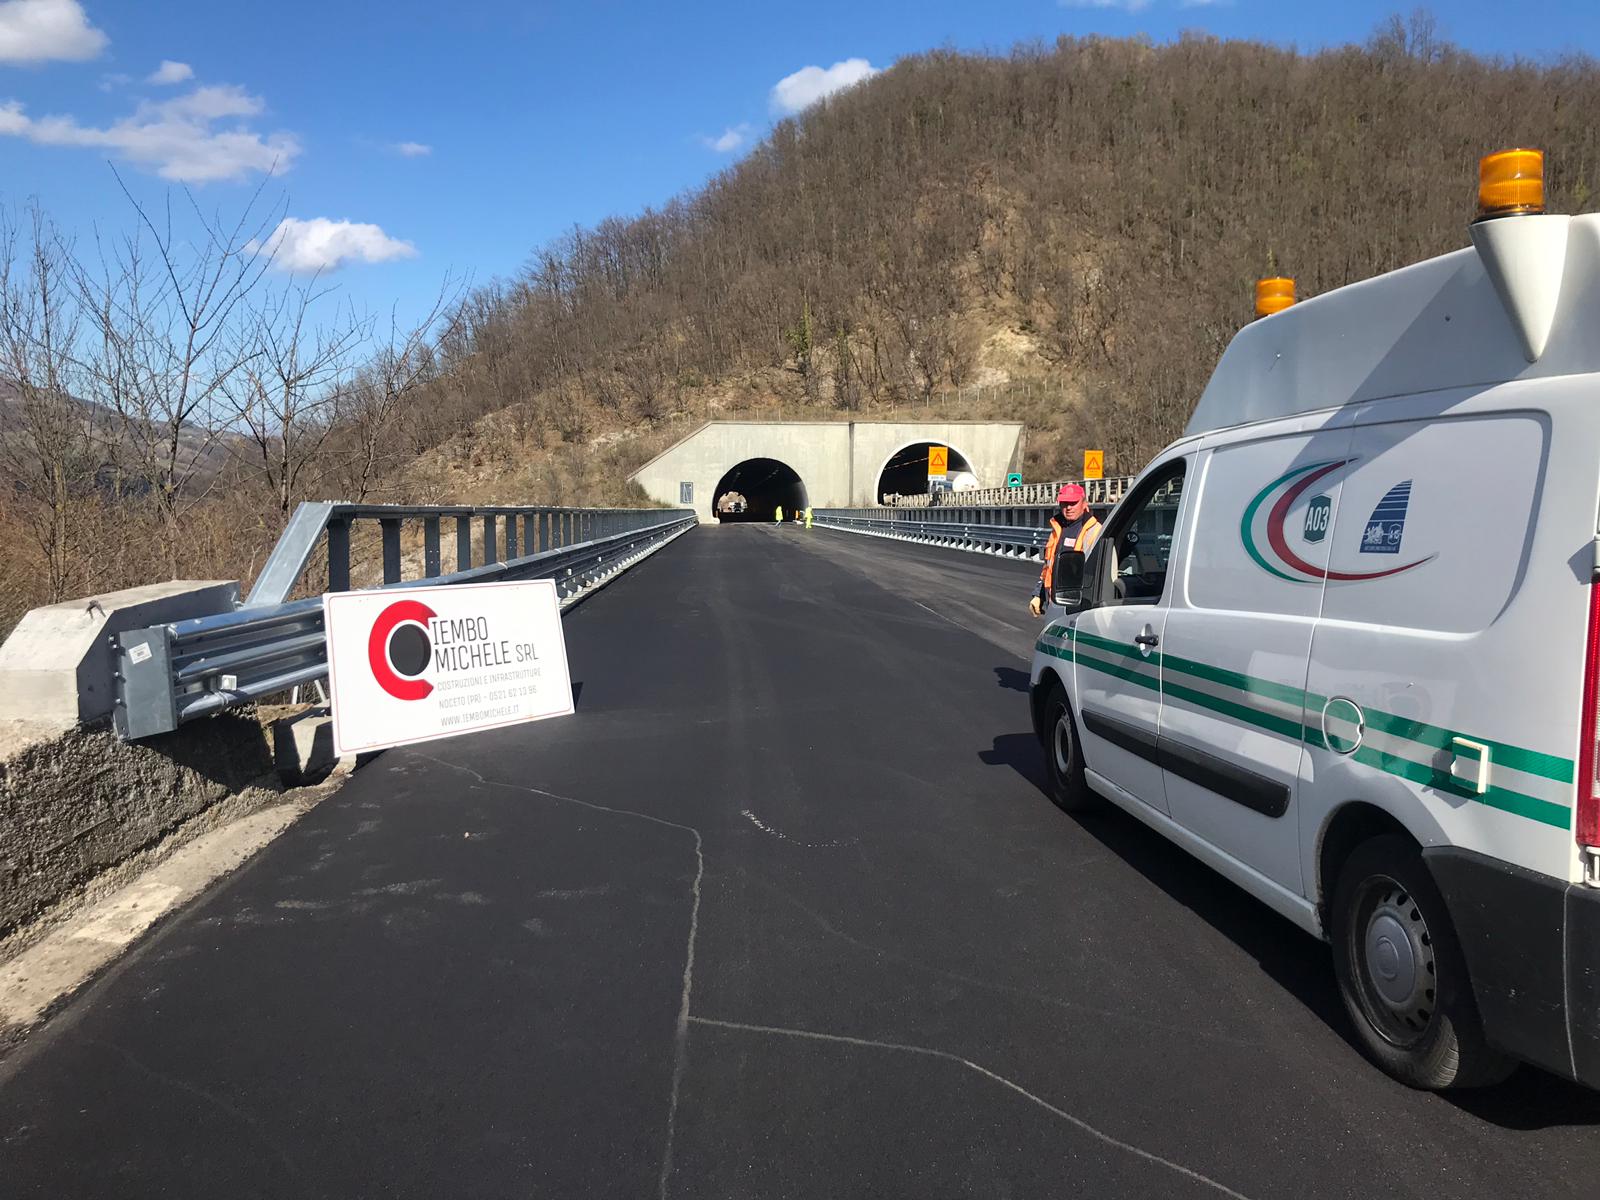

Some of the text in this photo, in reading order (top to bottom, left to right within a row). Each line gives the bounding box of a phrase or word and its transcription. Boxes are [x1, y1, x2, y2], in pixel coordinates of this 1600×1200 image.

[1305, 507, 1329, 532] A03
[432, 616, 489, 645] IEMBO
[434, 640, 540, 673] MICHELE SRL
[437, 667, 541, 692] COSTRUZIONI E INFRASTRUTTURE
[439, 696, 466, 710] NOCETO
[489, 689, 507, 701] 0521
